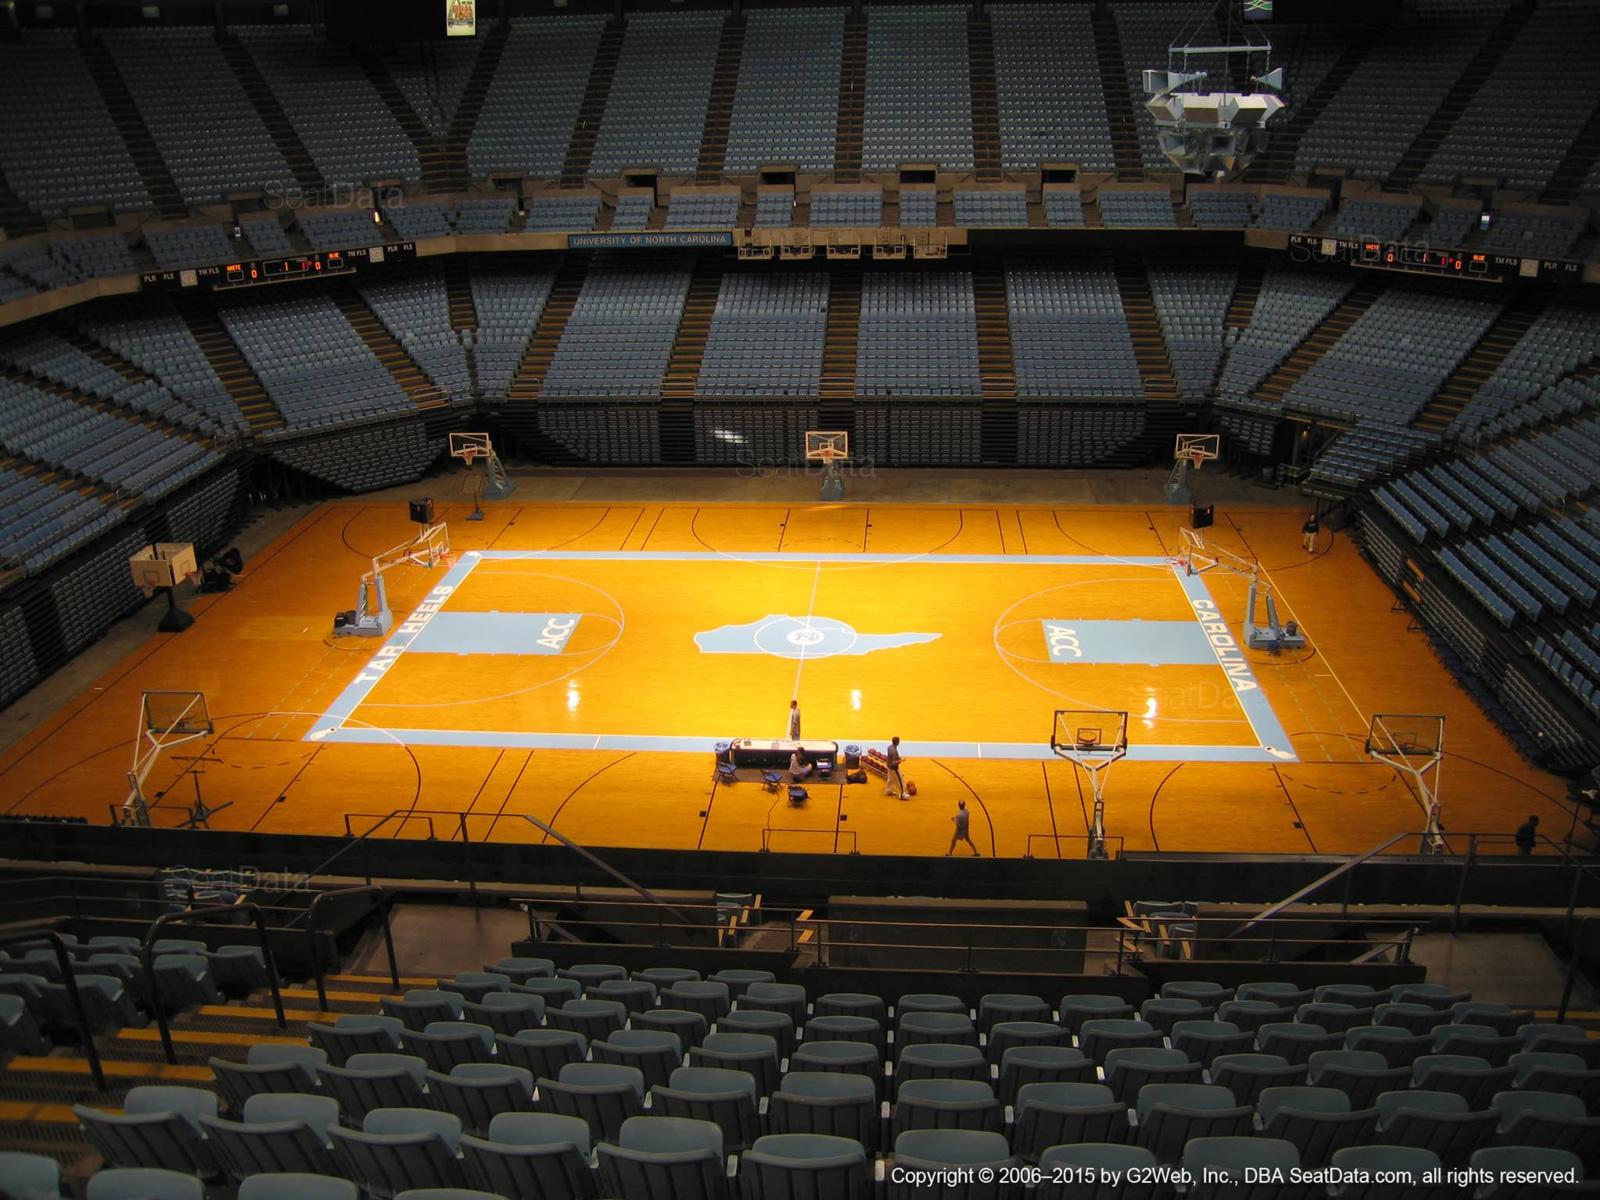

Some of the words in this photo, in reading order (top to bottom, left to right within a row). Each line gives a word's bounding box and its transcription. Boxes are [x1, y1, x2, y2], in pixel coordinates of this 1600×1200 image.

[573, 237, 626, 246] UNIVERSITY
[630, 236, 642, 244] OF
[645, 236, 677, 244] NORTH
[680, 235, 726, 243] CAROLINA
[1348, 242, 1359, 250] FLS
[1387, 253, 1394, 263] 0
[1505, 258, 1518, 266] FLS
[314, 261, 321, 271] 0
[1455, 260, 1462, 270] 0
[1544, 262, 1558, 270] PLR
[1565, 263, 1577, 272] FLS
[144, 274, 157, 282] PLR
[163, 272, 175, 280] FLS
[251, 269, 258, 279] 0
[354, 645, 404, 684] TAR
[398, 584, 454, 634] HEELS
[535, 617, 575, 649] ACC
[1047, 624, 1082, 657] ACC
[1192, 599, 1258, 692] CAROLINA
